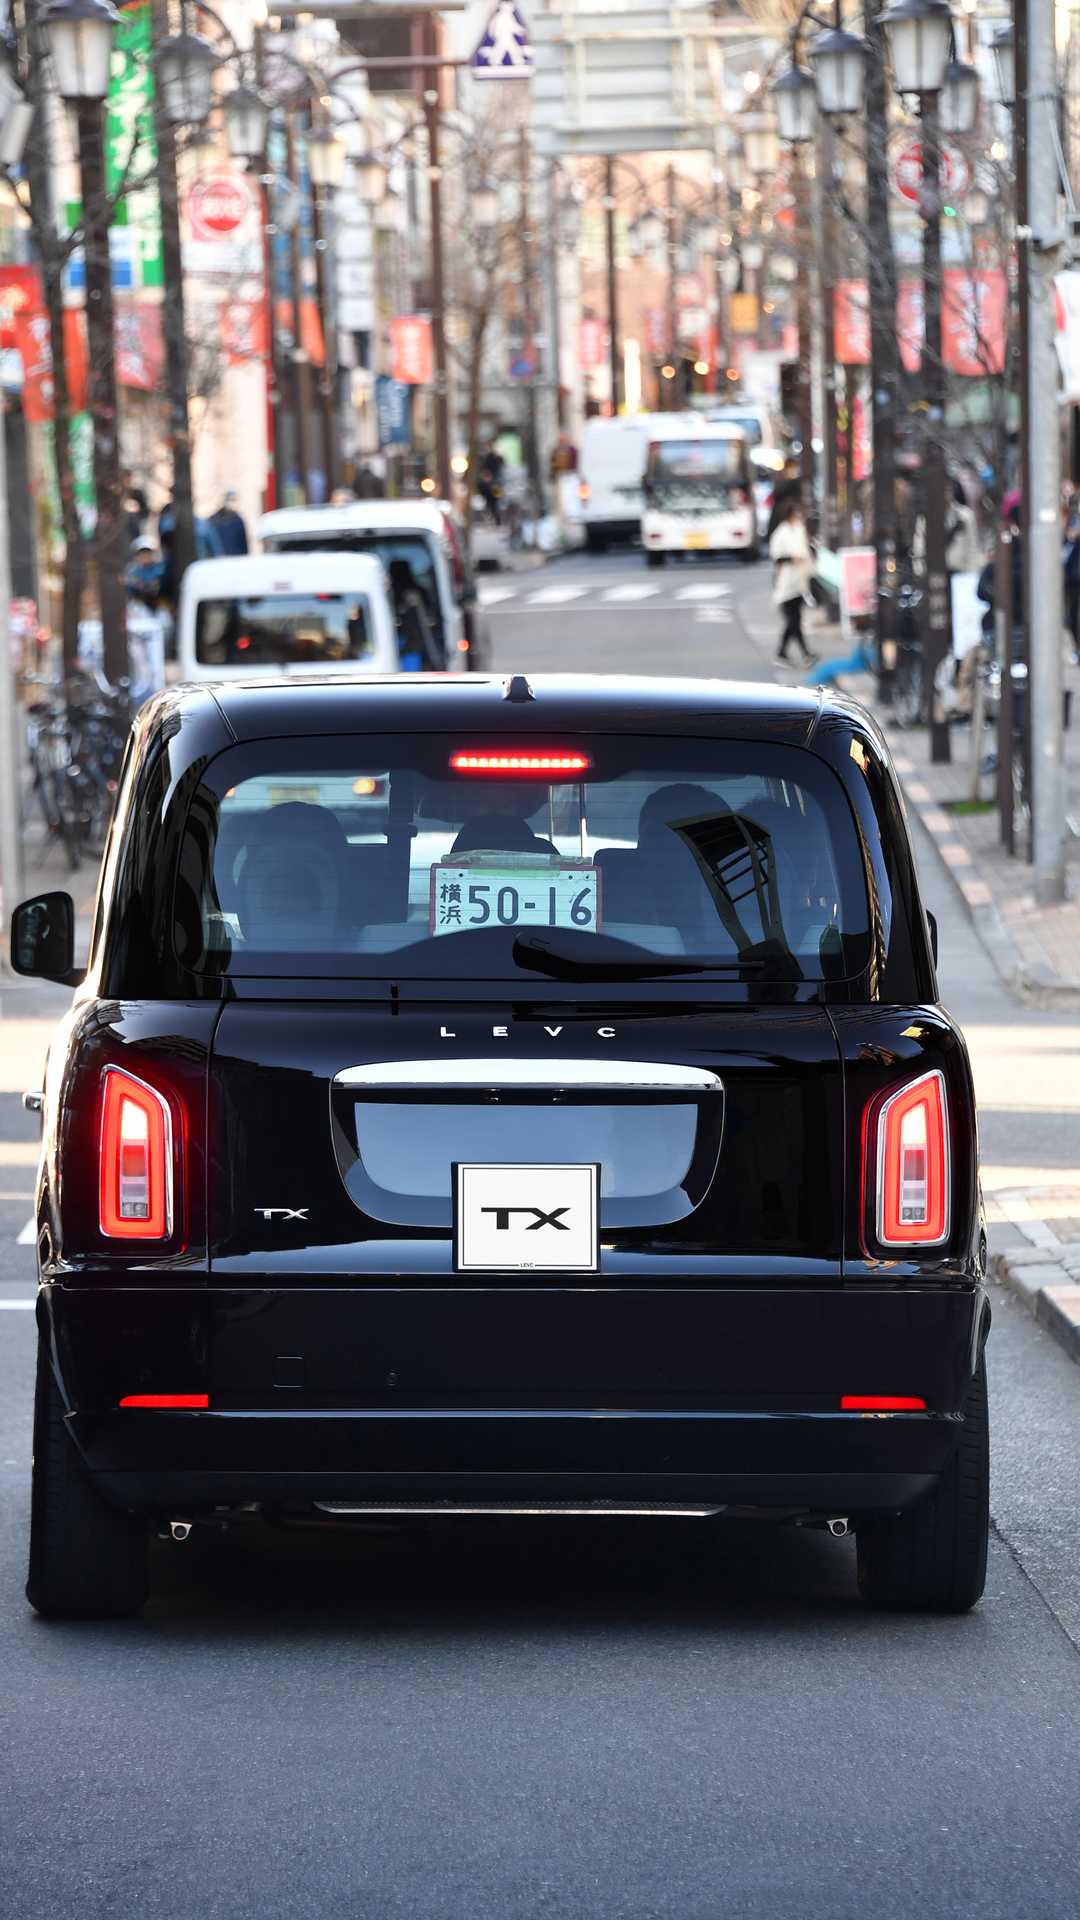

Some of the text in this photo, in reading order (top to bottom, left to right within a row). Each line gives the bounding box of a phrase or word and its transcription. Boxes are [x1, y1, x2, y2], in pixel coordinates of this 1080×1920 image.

[440, 883, 462, 925] 横浜
[468, 885, 592, 926] 50-16
[440, 1026, 616, 1037] LEVC
[254, 1208, 310, 1220] TX
[481, 1207, 571, 1230] TX
